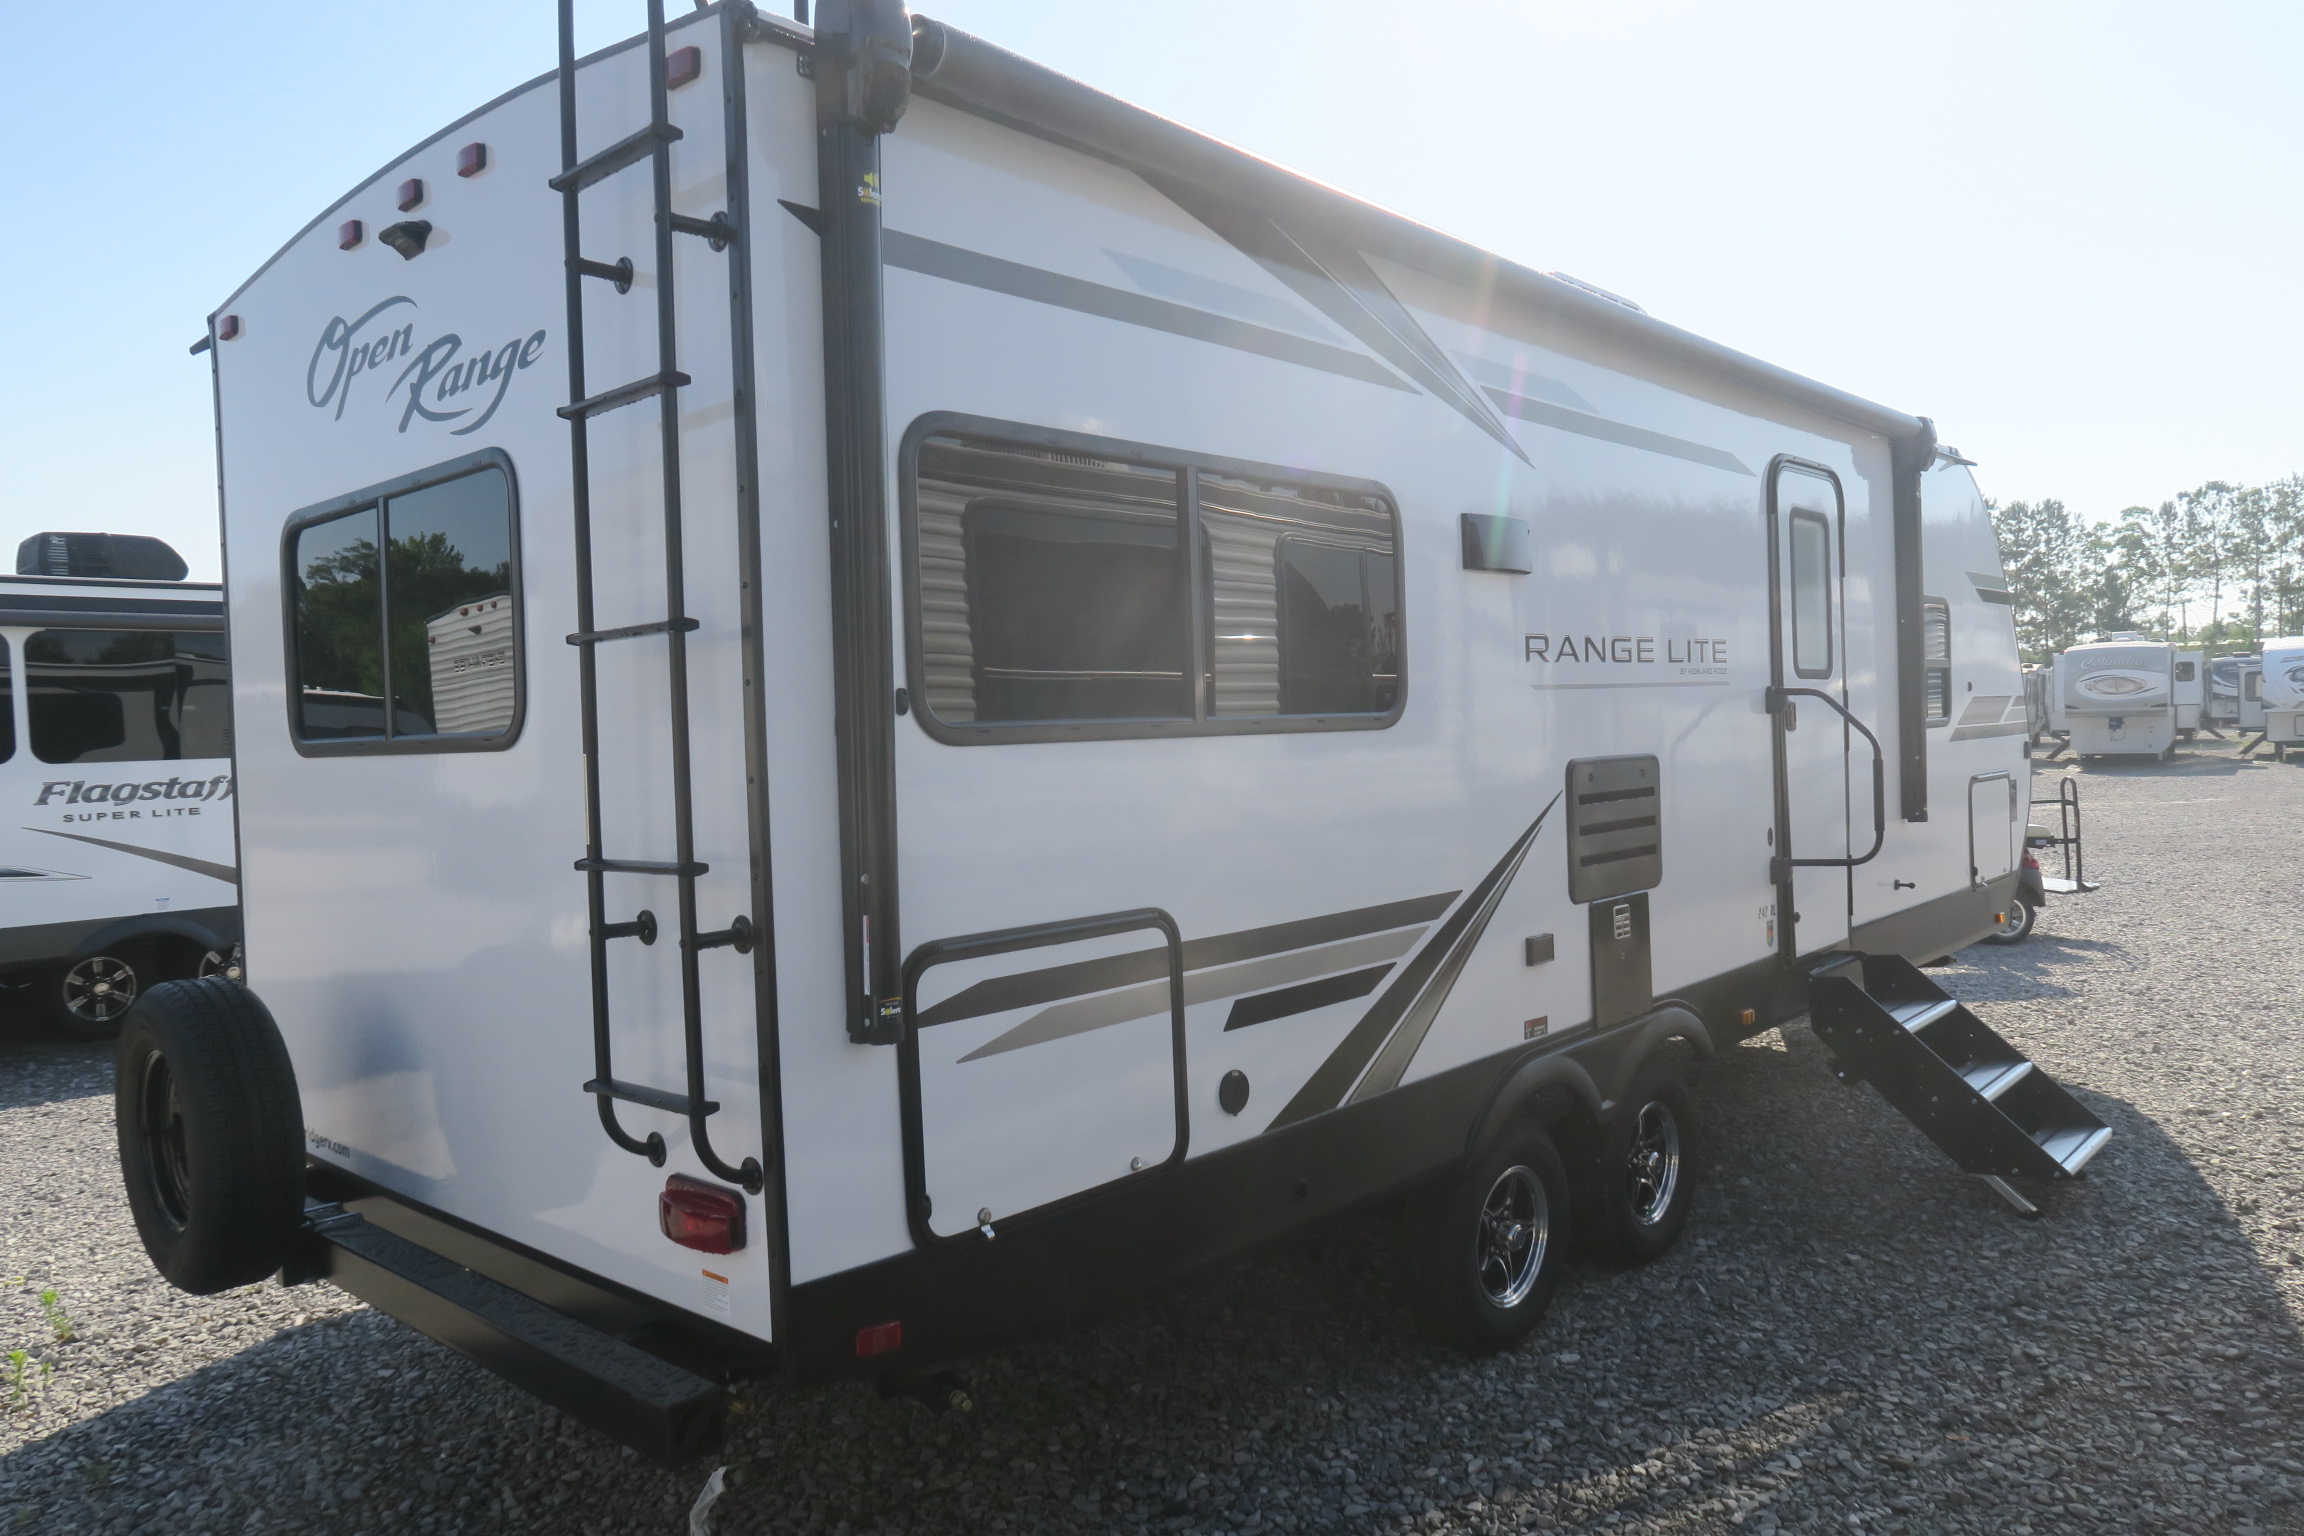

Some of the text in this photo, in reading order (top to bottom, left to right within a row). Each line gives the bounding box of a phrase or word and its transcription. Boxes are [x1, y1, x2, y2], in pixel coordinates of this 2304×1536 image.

[307, 295, 547, 436] Open Range
[1524, 633, 1728, 663] RANGE LITE
[2080, 656, 2148, 670] Columbus
[62, 807, 202, 823] SUPER LITE
